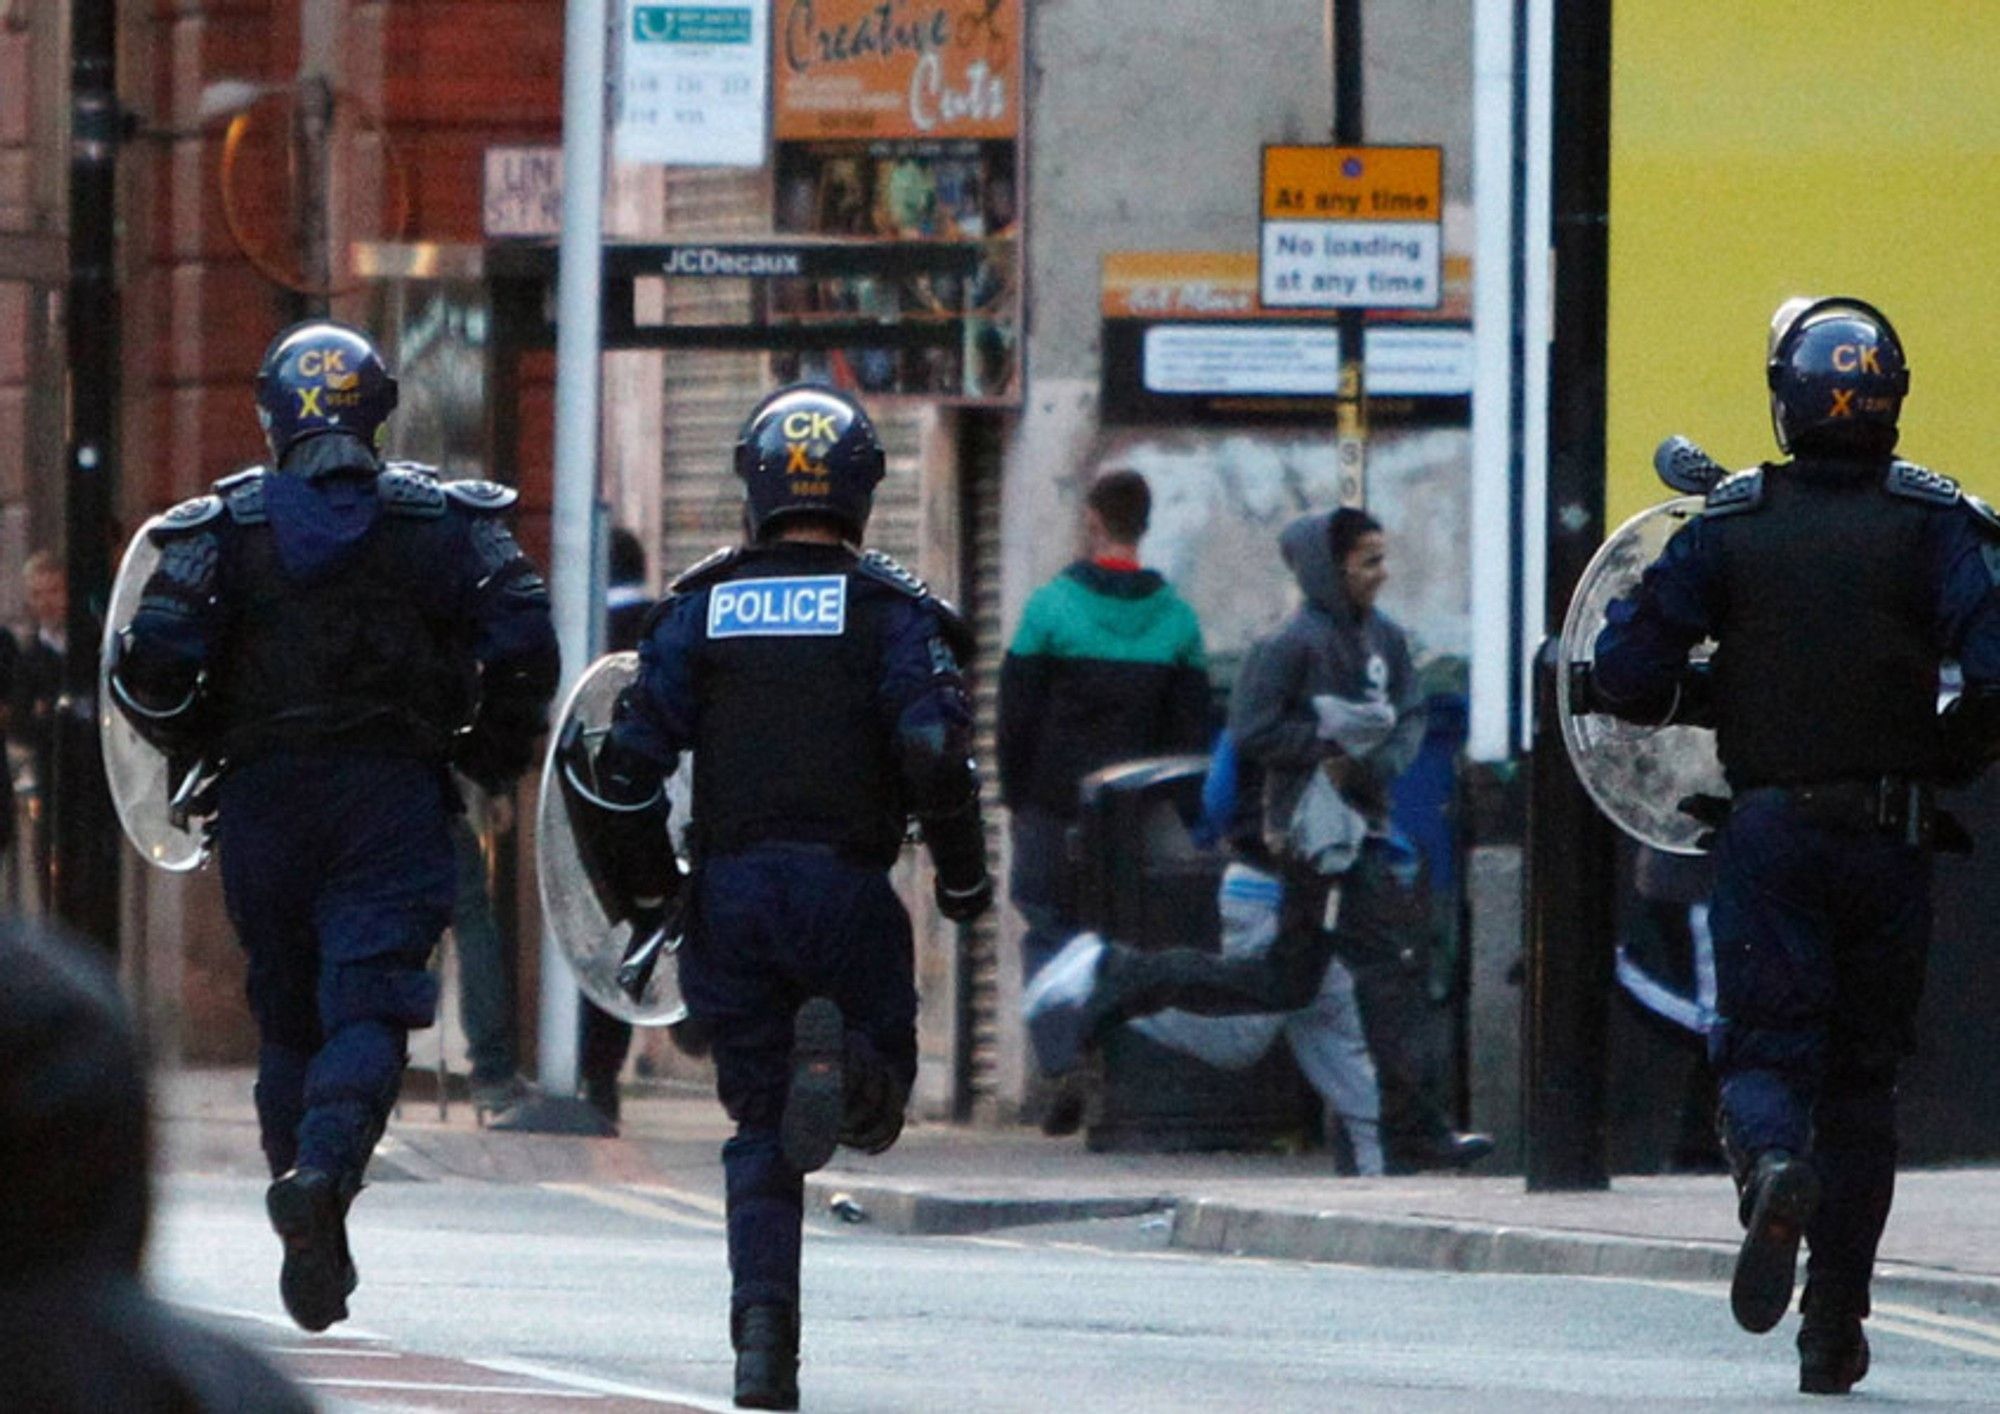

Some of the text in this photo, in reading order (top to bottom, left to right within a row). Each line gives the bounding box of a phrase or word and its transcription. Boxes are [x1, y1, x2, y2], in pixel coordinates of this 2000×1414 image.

[909, 51, 1004, 131] Cuts
[1277, 188, 1429, 213] At any time
[662, 248, 799, 274] JCDecaux
[1278, 231, 1421, 261] No loading
[1276, 270, 1425, 297] at any time
[298, 350, 345, 377] CK
[1831, 343, 1883, 375] CK
[297, 386, 325, 419] X
[1828, 388, 1857, 417] X
[783, 412, 840, 442] CK
[786, 442, 810, 474] X
[714, 588, 842, 625] POLICE
